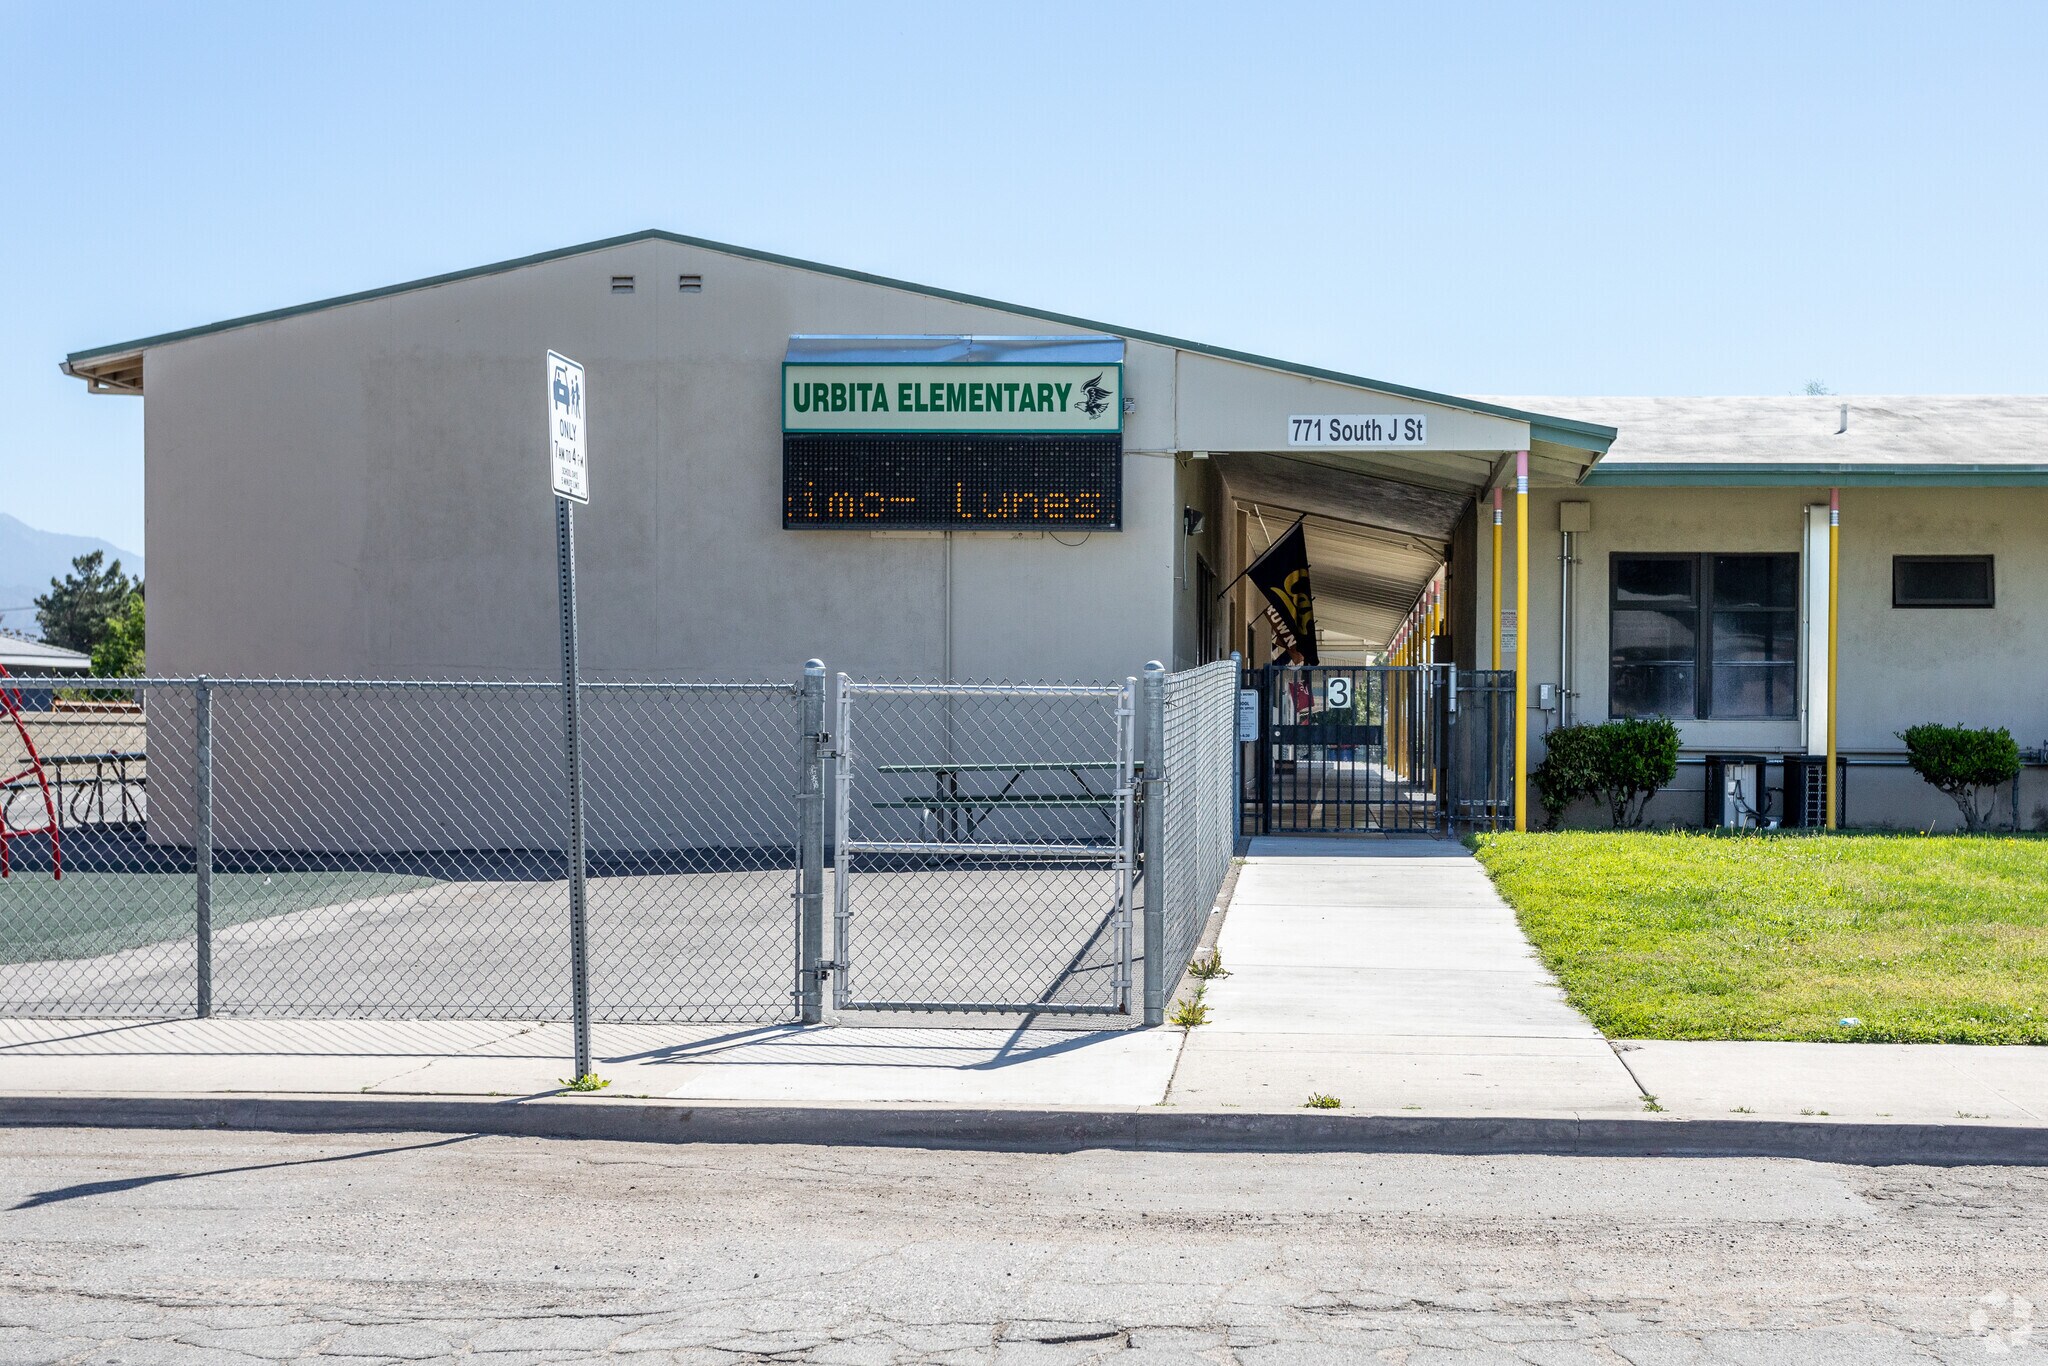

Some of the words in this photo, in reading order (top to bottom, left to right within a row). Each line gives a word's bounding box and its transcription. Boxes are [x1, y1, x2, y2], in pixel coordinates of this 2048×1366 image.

[793, 382, 889, 413] URBITA
[898, 382, 1072, 413] ELEMENTARY
[560, 418, 576, 441] ONLY
[1292, 418, 1321, 441] 771
[1329, 418, 1382, 441] South
[1388, 418, 1398, 441] J
[1404, 418, 1423, 441] St
[572, 448, 576, 465] 4
[788, 481, 915, 518] imo-
[1329, 678, 1348, 706] 3
